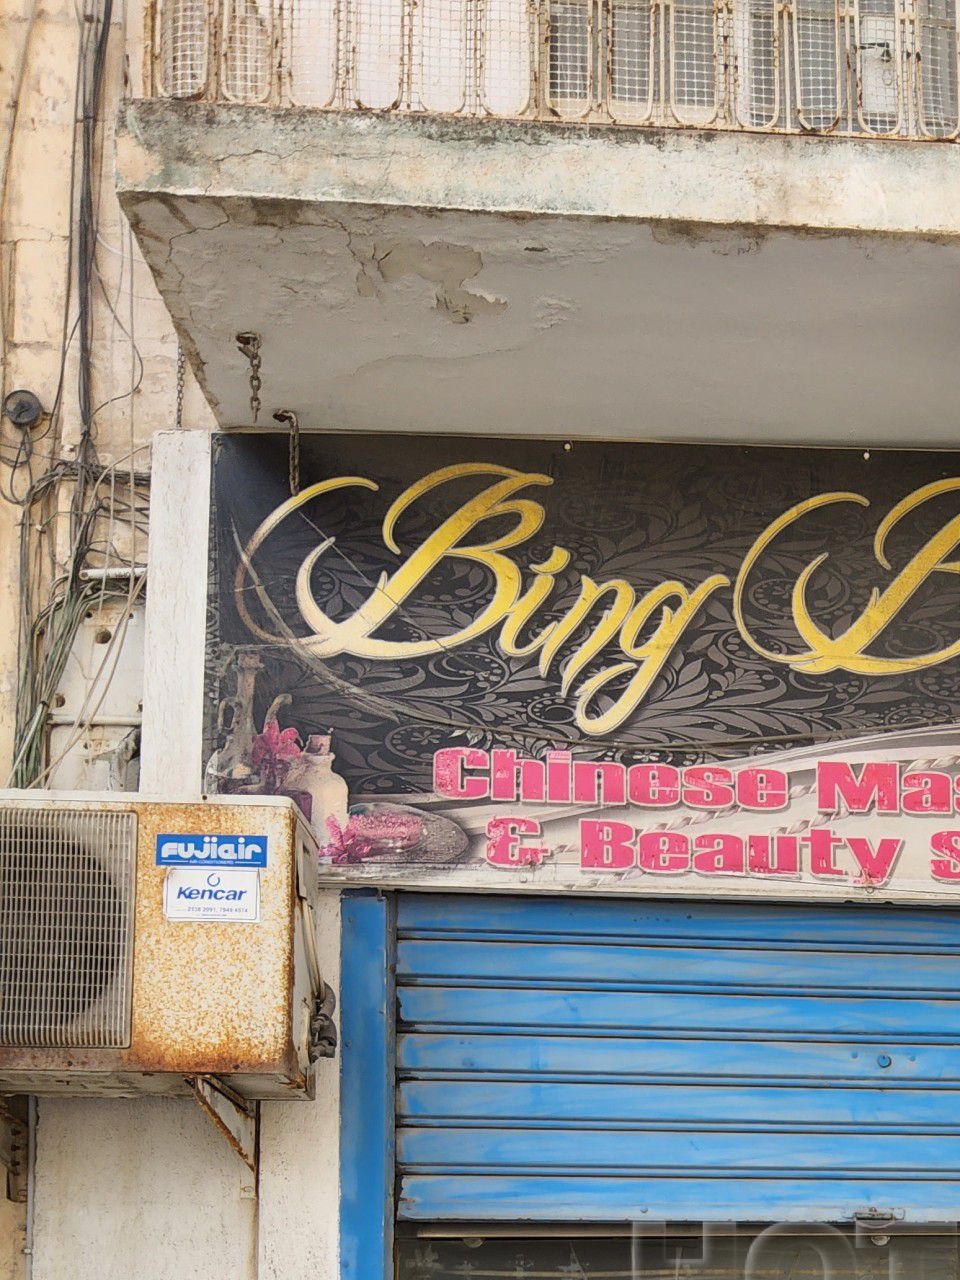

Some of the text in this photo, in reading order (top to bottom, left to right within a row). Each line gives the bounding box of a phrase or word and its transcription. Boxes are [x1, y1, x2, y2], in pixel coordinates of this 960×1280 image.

[236, 462, 730, 735] Bing
[432, 746, 788, 811] Chinese
[485, 818, 550, 866] &
[580, 819, 902, 885] Beauty
[177, 887, 248, 900] Kencar
